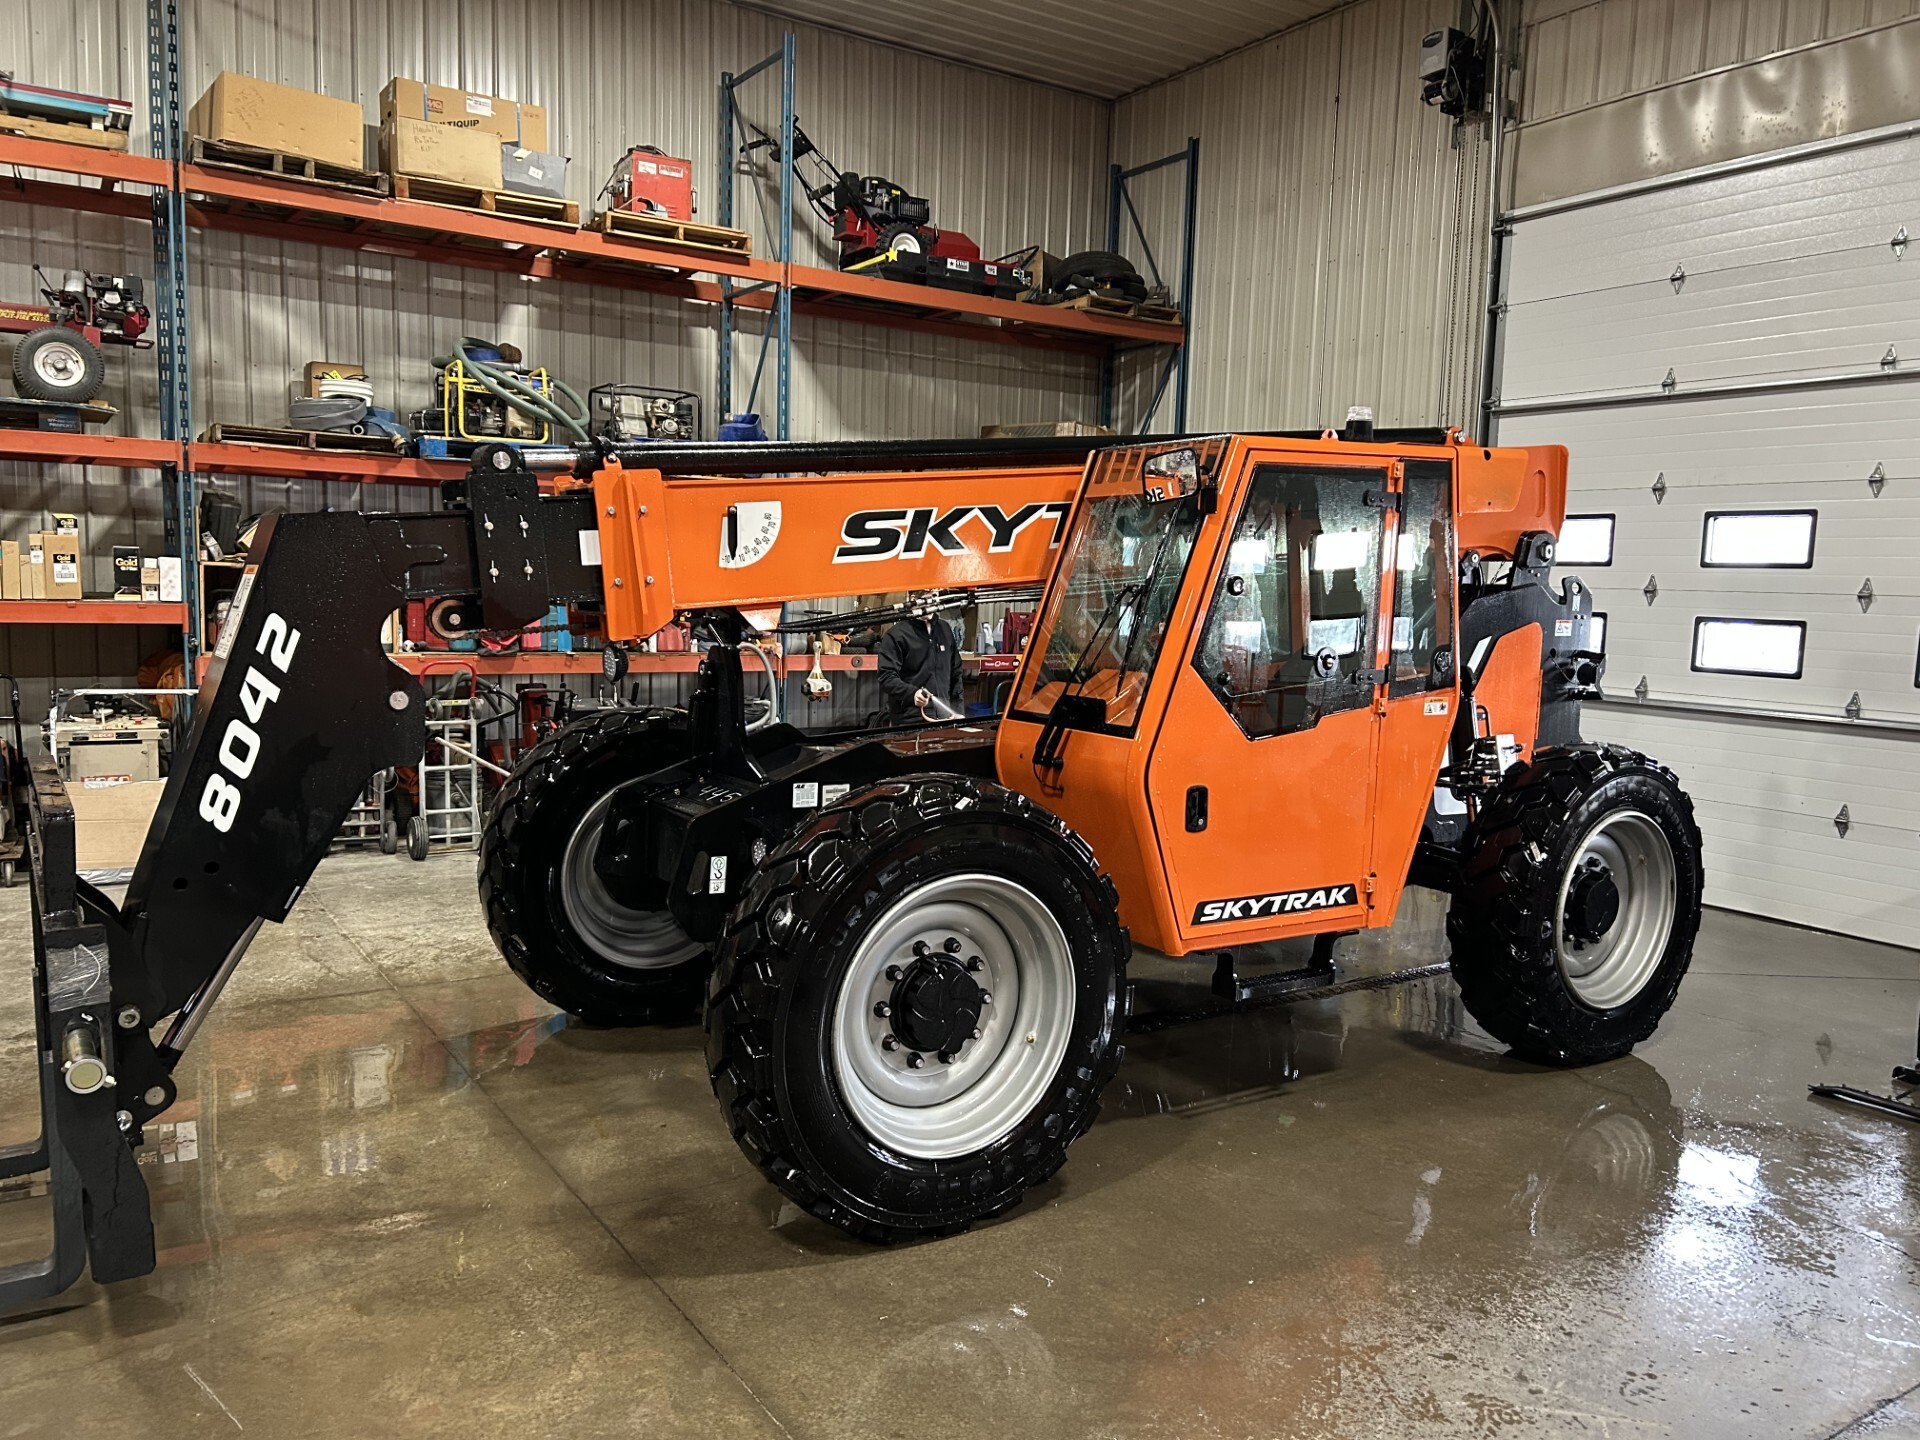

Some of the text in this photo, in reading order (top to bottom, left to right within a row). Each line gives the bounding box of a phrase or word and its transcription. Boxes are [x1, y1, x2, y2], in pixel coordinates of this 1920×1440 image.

[439, 119, 480, 128] TIQUIP
[115, 557, 138, 567] Gold
[199, 612, 301, 833] 8042
[698, 785, 743, 803] 445
[1199, 886, 1351, 922] SKYTRAK
